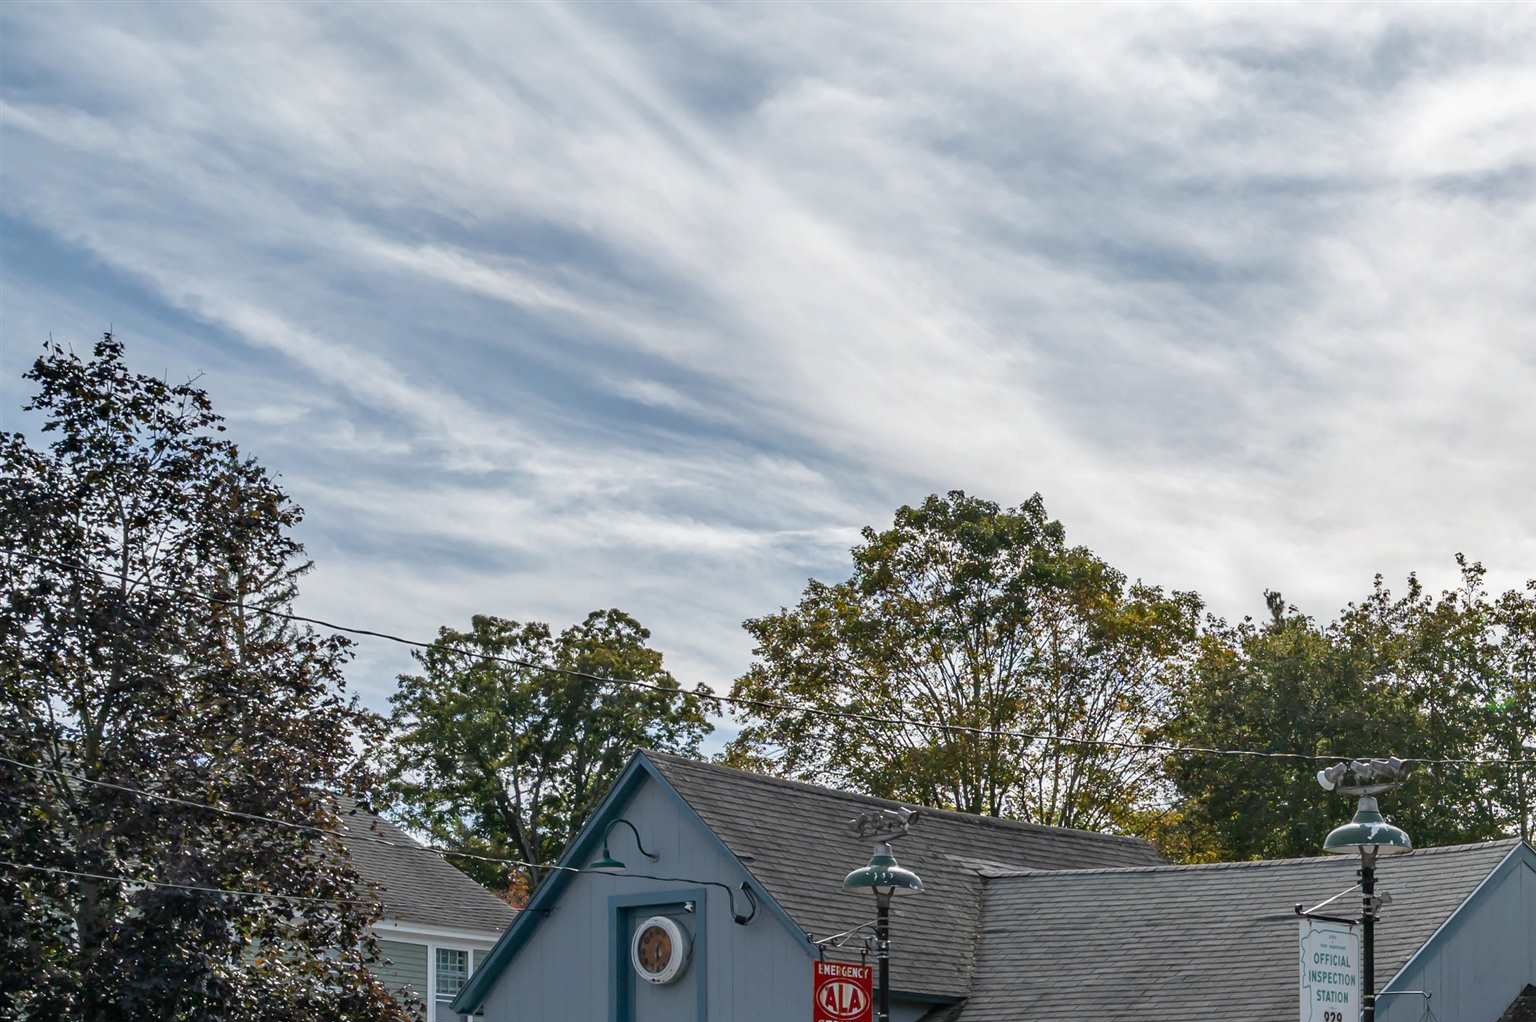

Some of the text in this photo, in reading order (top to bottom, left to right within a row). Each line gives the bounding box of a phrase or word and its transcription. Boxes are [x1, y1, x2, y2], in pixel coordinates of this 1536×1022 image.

[1313, 953, 1351, 968] OFFICIAL
[818, 963, 869, 979] EMERGENCY
[1308, 970, 1356, 986] INSPECTION
[824, 983, 864, 1012] ALA
[1316, 990, 1349, 1004] STATION
